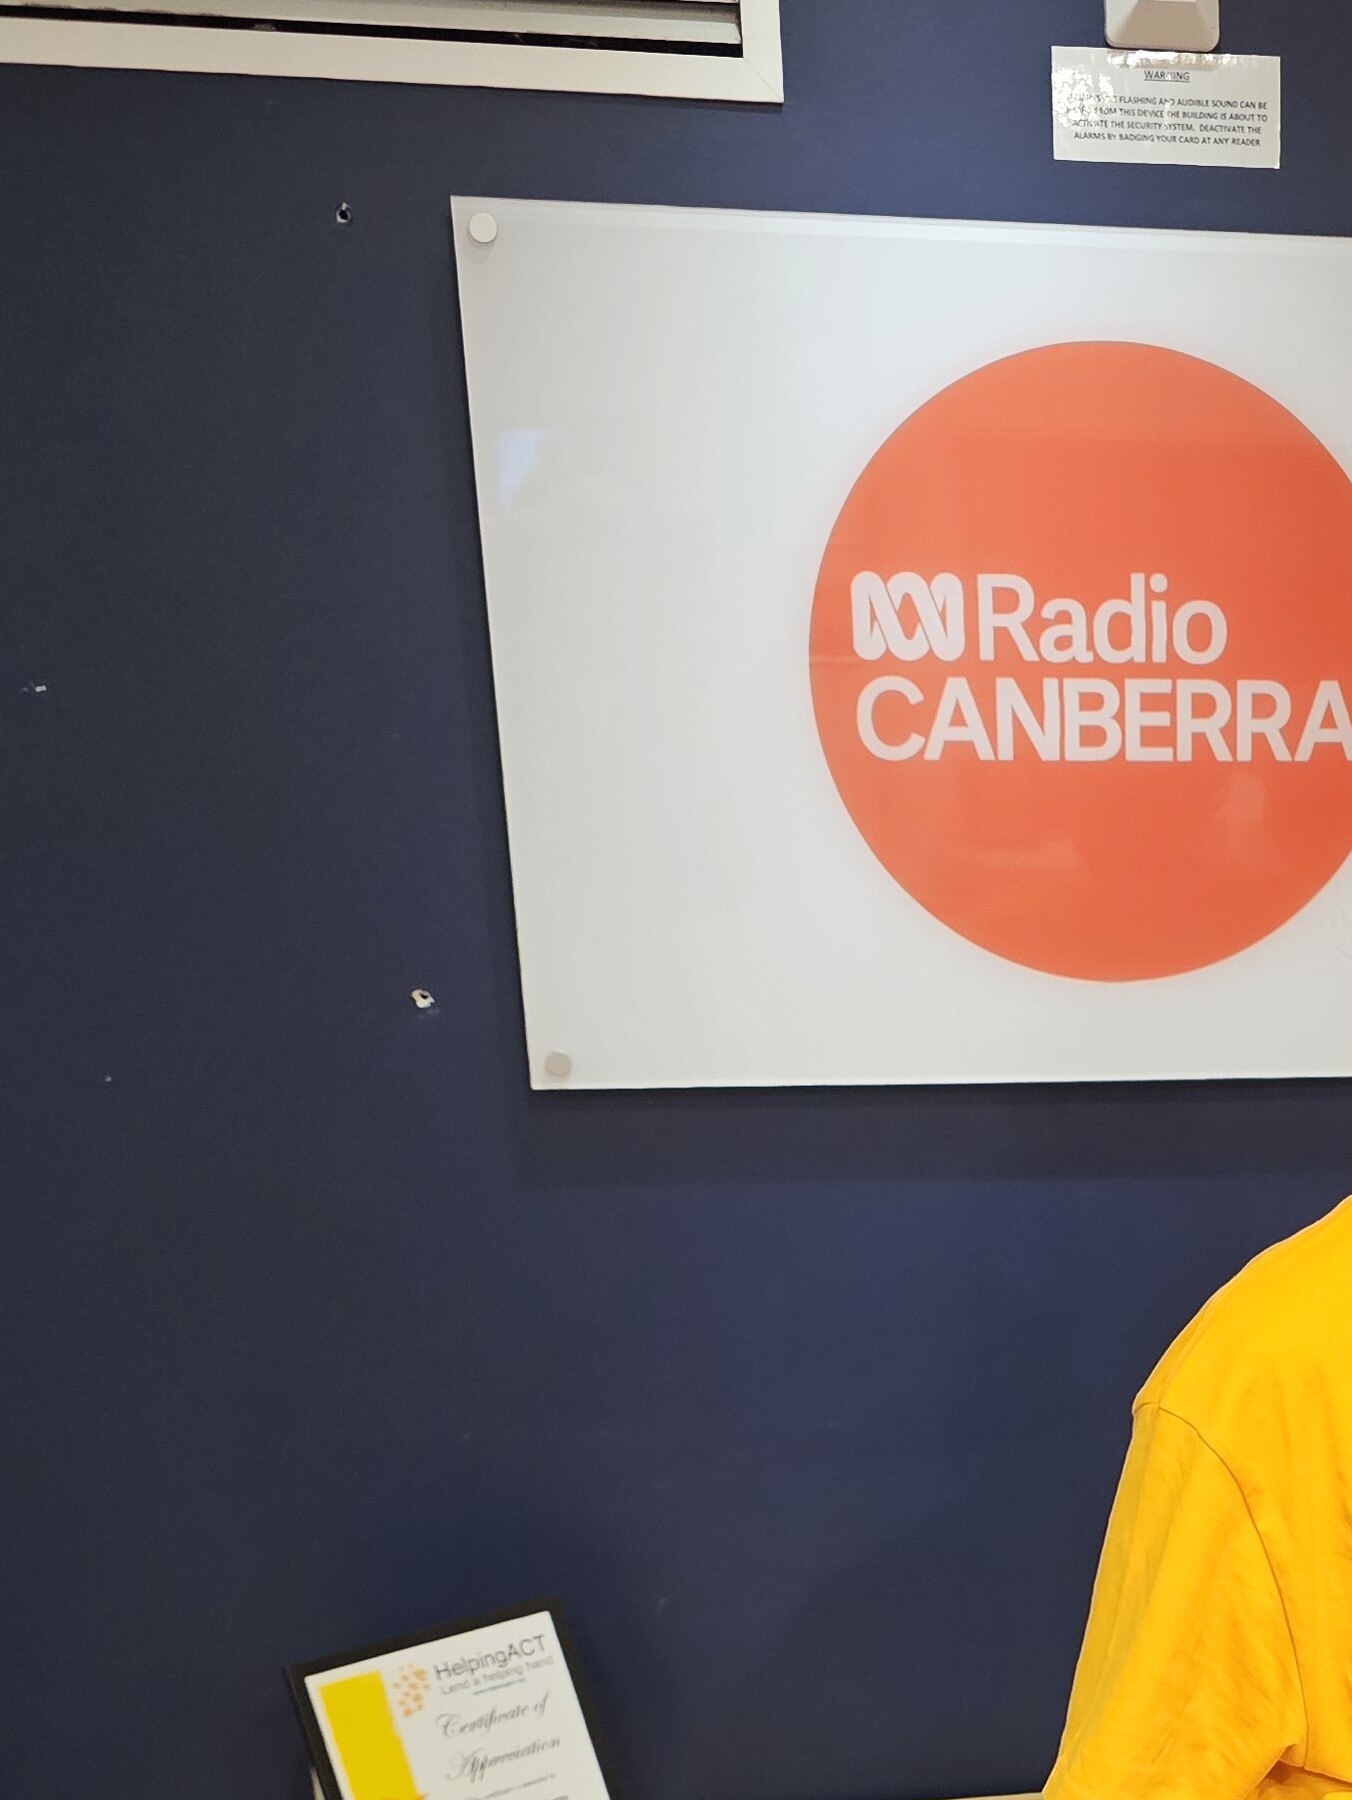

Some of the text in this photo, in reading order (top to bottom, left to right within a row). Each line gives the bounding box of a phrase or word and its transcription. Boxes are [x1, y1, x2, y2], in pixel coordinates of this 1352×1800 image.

[1119, 95, 1157, 105] FLASHING
[1177, 98, 1209, 108] AUDIBLE
[1212, 99, 1238, 108] SOUND
[1240, 100, 1256, 110] CAN
[1258, 101, 1267, 110] BE
[1119, 108, 1135, 116] THIS
[1137, 109, 1164, 118] DEVICE
[1182, 111, 1218, 120] BUILDING
[1220, 112, 1227, 120] IS
[1229, 113, 1255, 121] ABOUT
[1257, 114, 1268, 122] TO
[1111, 120, 1125, 129] THE
[1127, 121, 1162, 130] SECURITY
[1199, 124, 1245, 133] DEACTIVATE
[1247, 126, 1261, 134] THE
[1074, 131, 1261, 146] ALARMS BY BADGING YOUR CARD AT ANY READER
[977, 572, 1228, 664] Radio
[433, 1633, 546, 1681] HelpingACT
